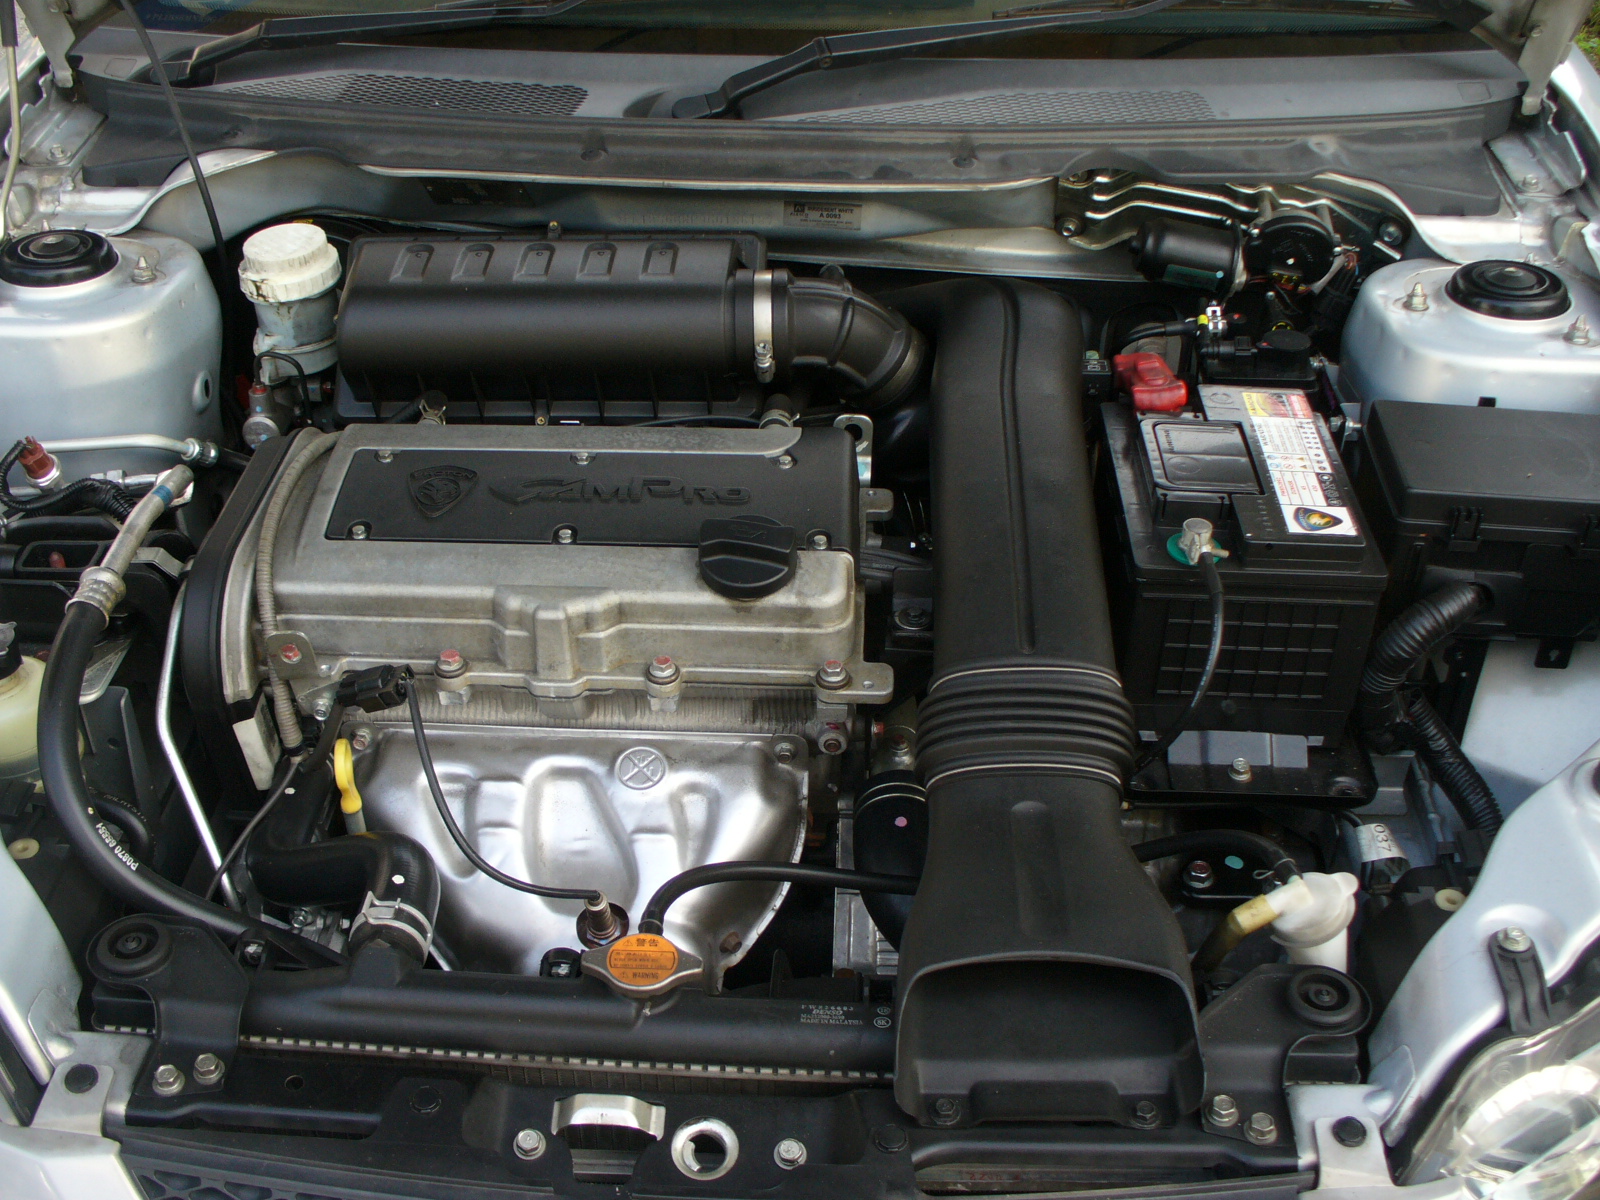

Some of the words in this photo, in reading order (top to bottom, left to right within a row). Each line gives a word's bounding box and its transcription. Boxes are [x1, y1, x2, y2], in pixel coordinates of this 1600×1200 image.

[1374, 824, 1392, 852] 037
[114, 845, 139, 871] P0870
[632, 971, 659, 980] WARNING
